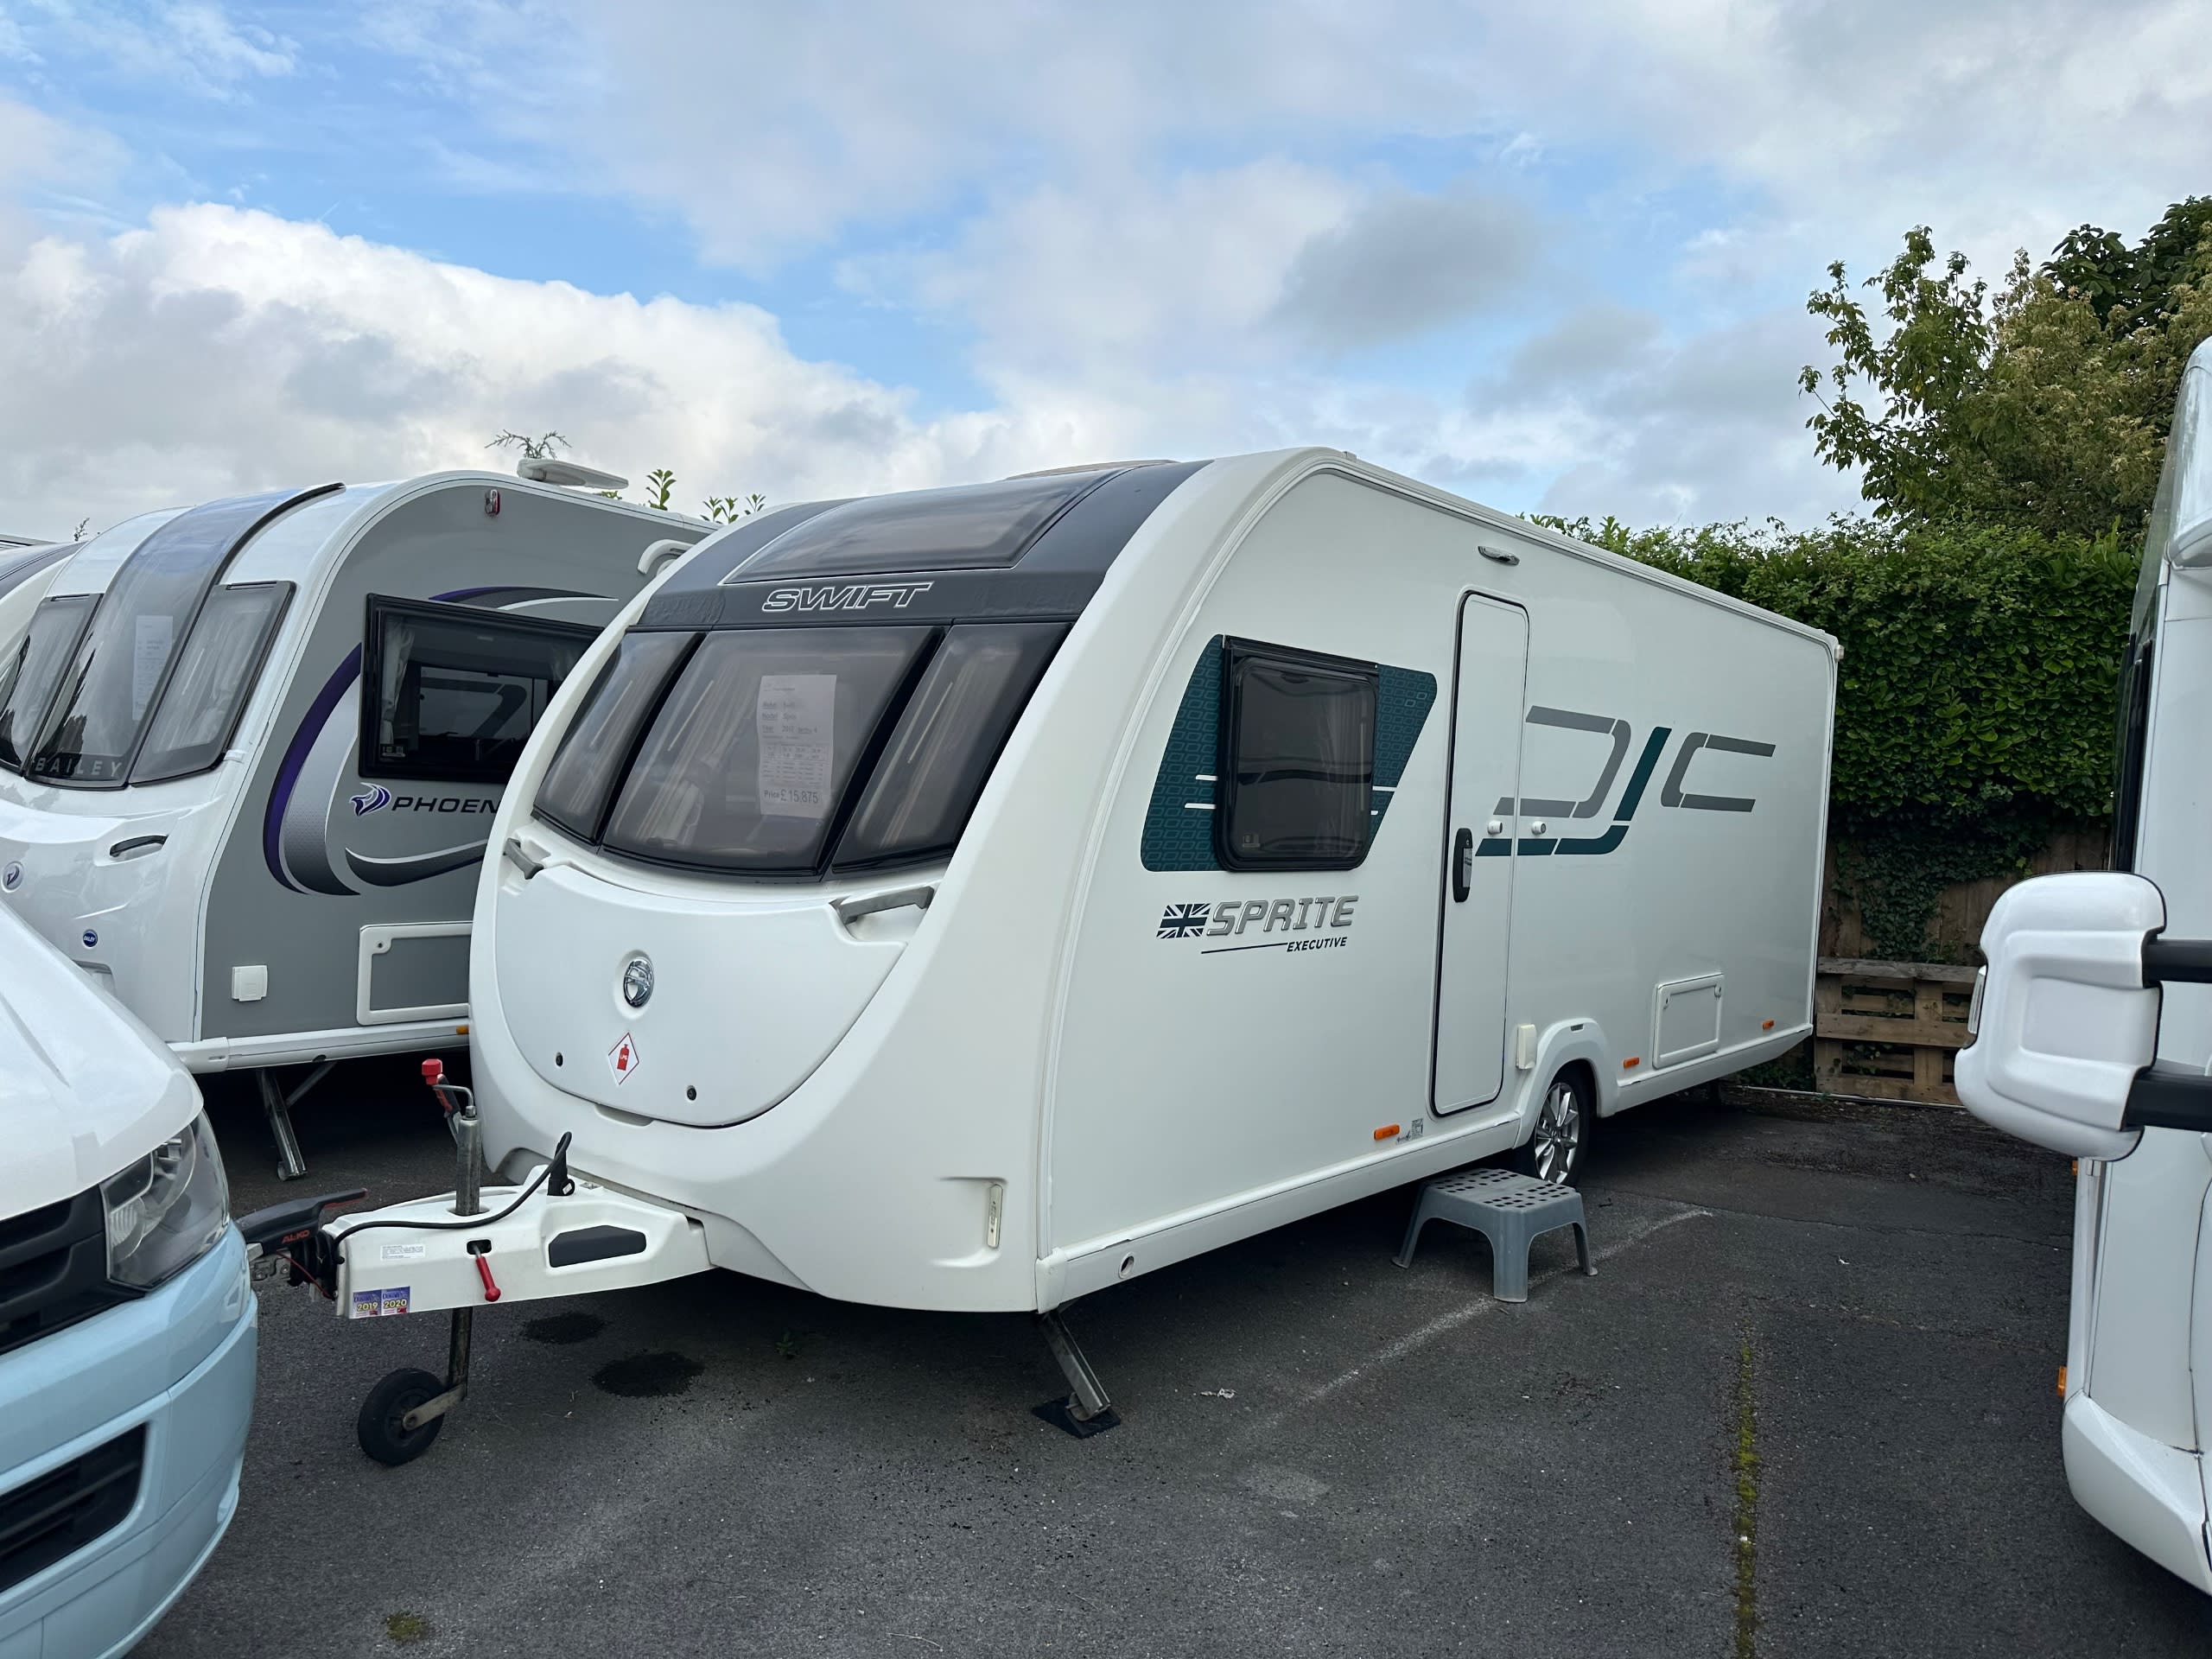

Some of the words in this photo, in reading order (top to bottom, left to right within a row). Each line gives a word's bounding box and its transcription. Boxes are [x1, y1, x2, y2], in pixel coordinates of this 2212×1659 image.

[761, 581, 935, 613] SWIFT
[35, 757, 123, 778] BAILEY
[1206, 894, 1359, 937] SPRITE
[1287, 937, 1348, 952] EXECUTIVE
[356, 1301, 378, 1312] 2019
[383, 1299, 407, 1309] 2020
